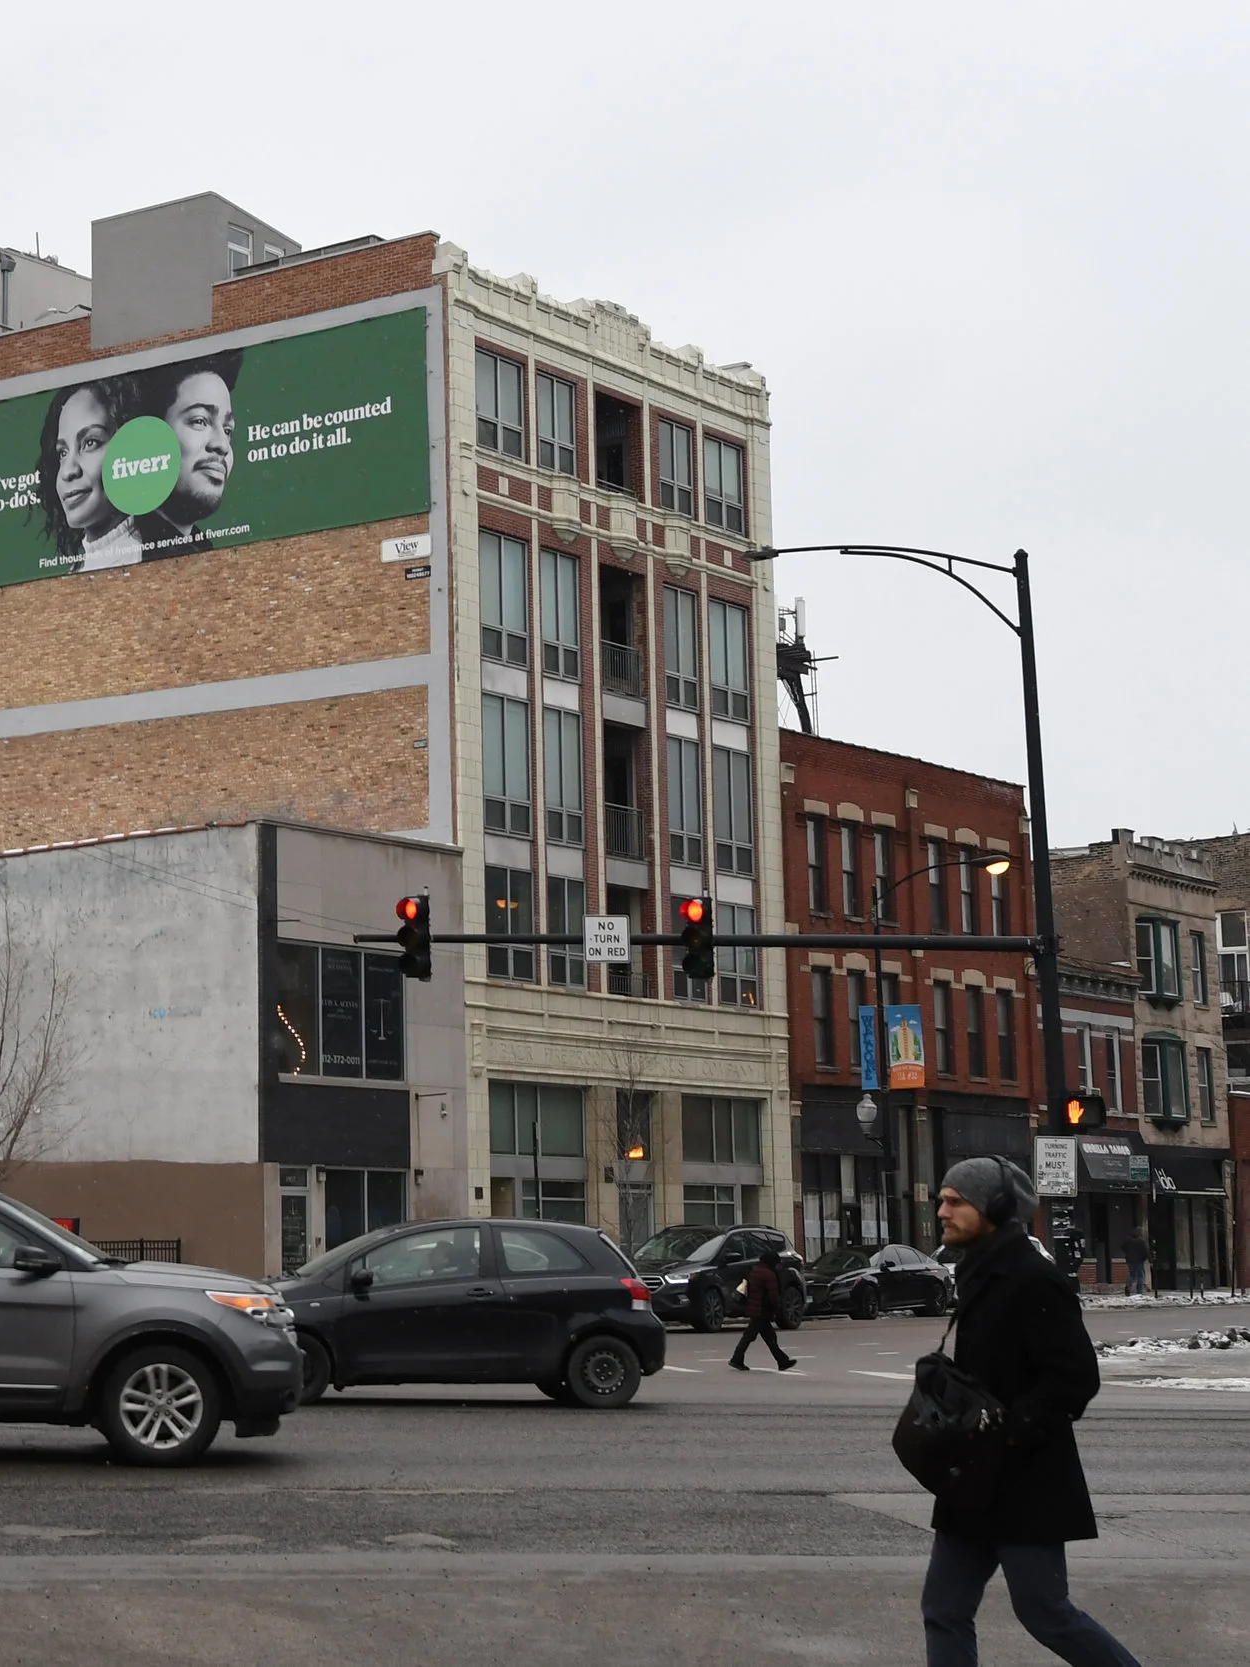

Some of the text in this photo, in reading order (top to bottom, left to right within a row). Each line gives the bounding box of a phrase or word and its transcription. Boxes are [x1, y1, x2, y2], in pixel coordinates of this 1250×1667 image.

[247, 396, 392, 442] He can be counted
[247, 427, 352, 463] on to do it all.
[112, 453, 171, 480] fiverr
[17, 469, 41, 491] got
[39, 556, 58, 568] Find
[156, 535, 193, 548] services
[194, 531, 204, 541] at
[205, 524, 250, 539] fiverr.com
[395, 539, 419, 554] View
[597, 921, 615, 931] NO
[593, 934, 620, 943] TURN
[588, 947, 626, 956] ON RED
[1045, 1161, 1066, 1169] MUST
